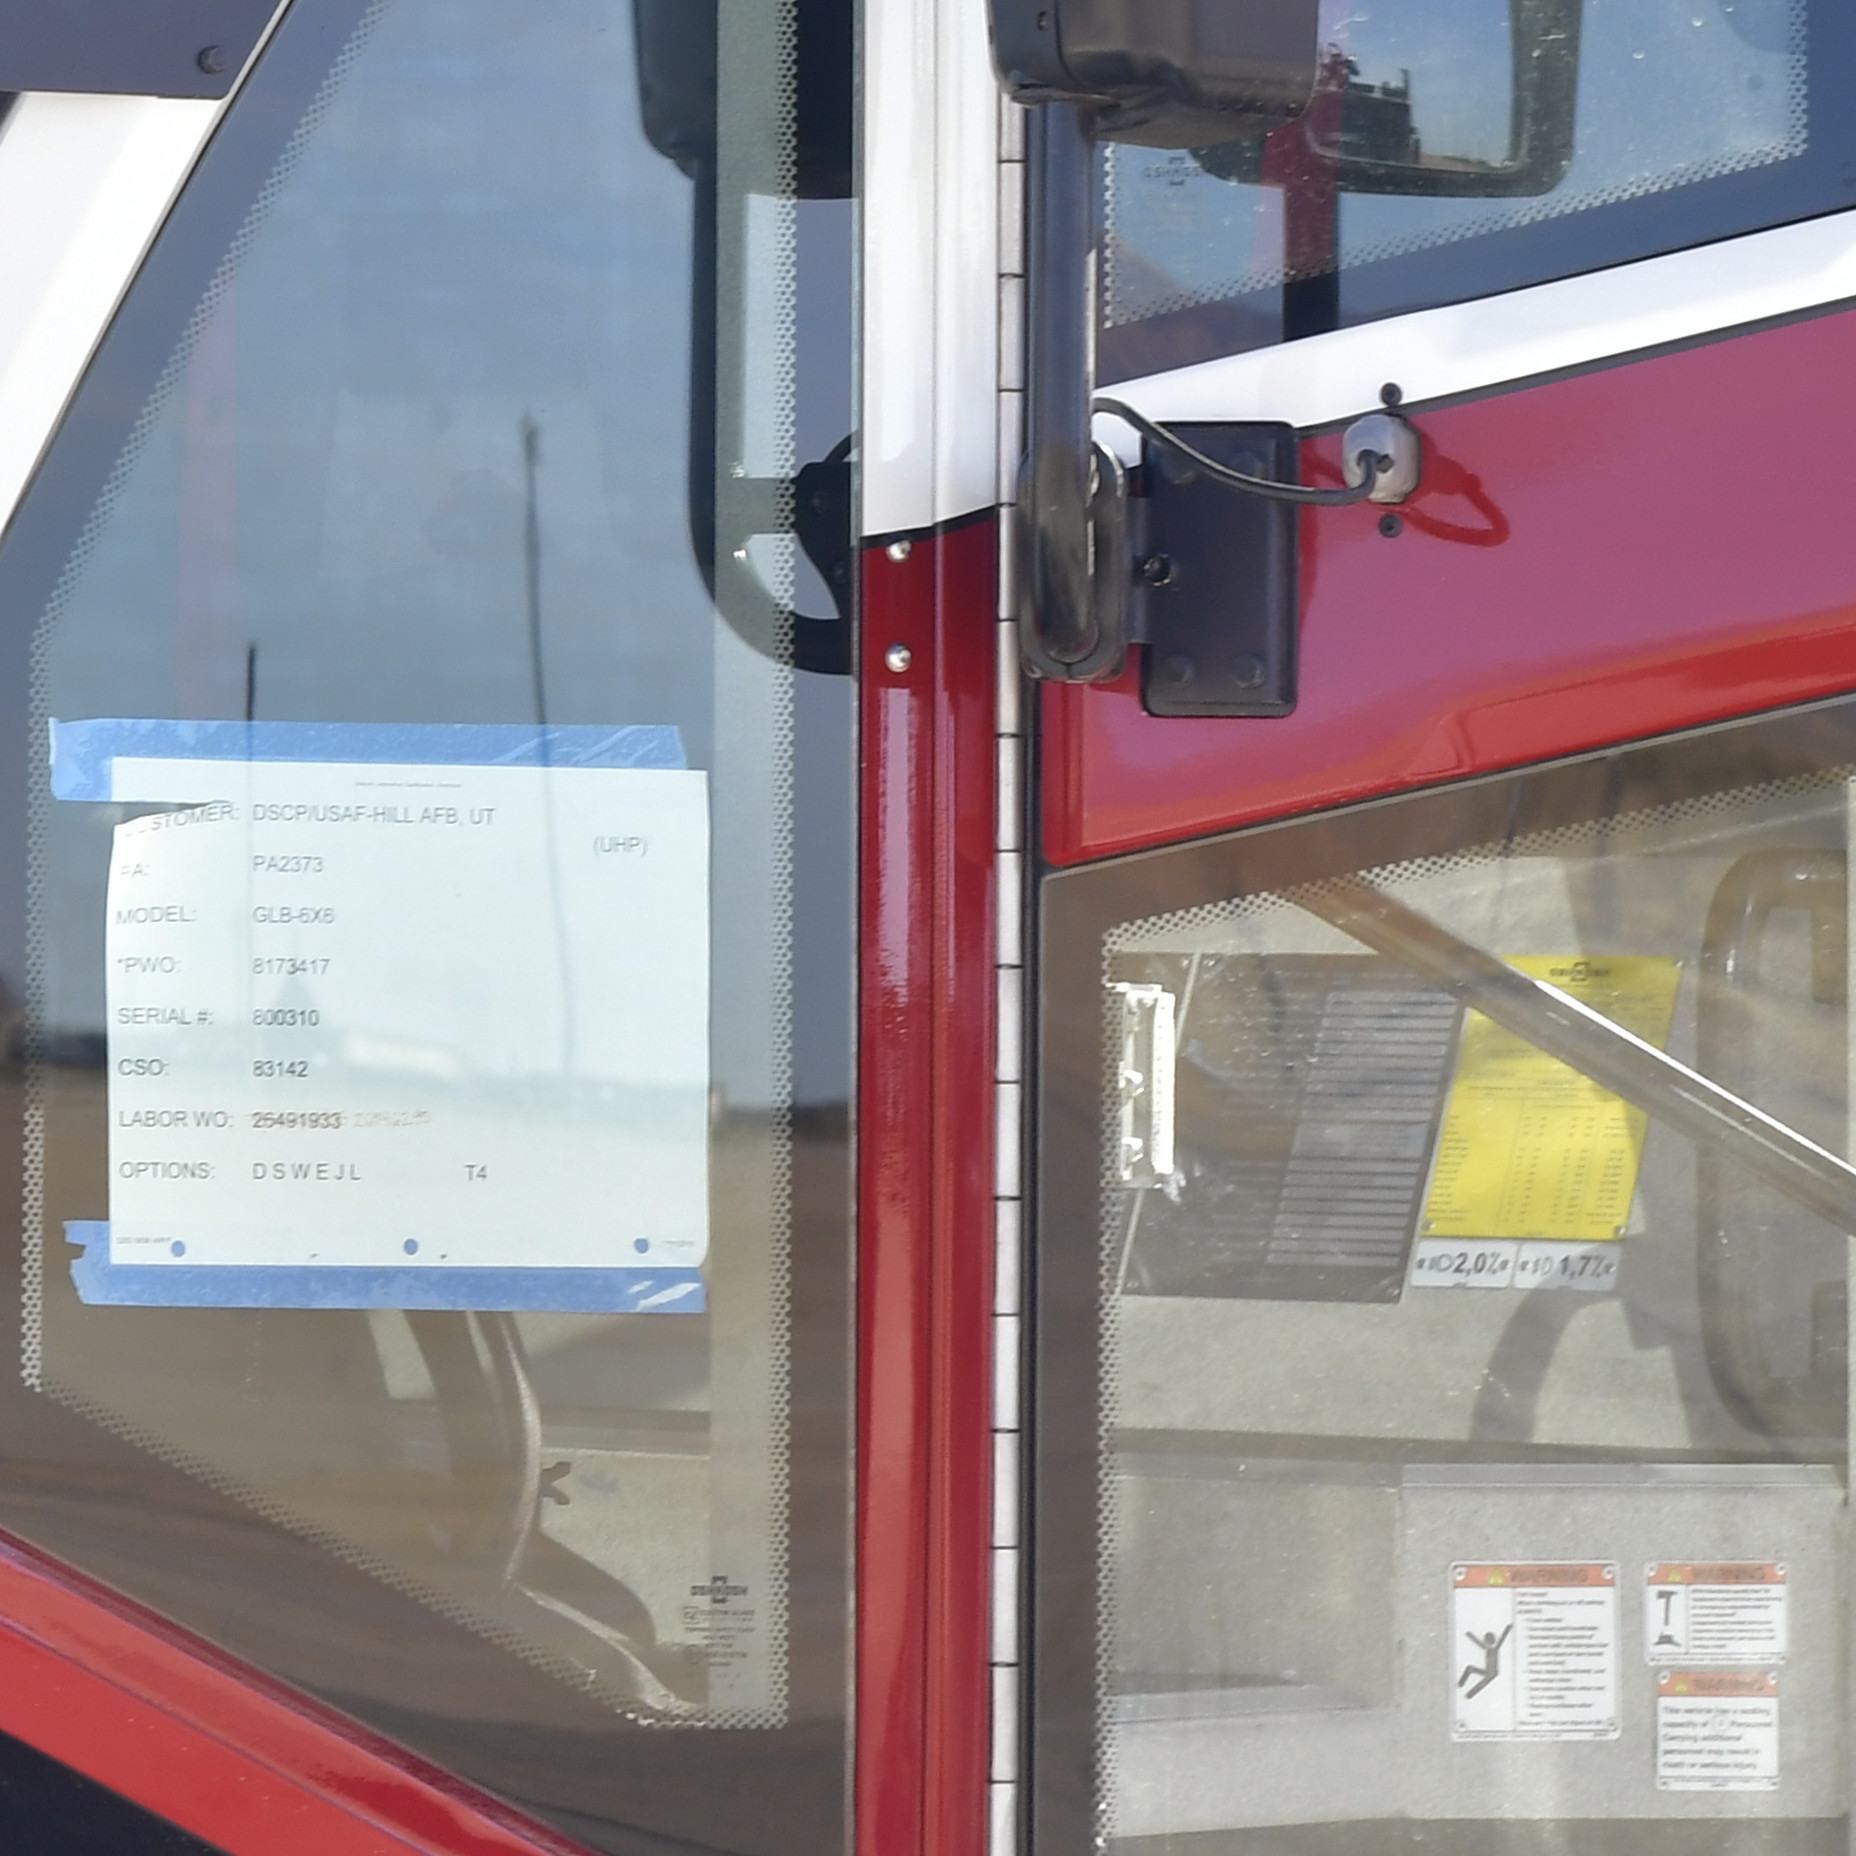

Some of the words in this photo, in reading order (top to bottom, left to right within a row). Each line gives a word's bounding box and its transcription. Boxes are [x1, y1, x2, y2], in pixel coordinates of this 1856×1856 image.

[251, 803, 414, 826] DSCP/USAF-HILL
[469, 808, 496, 826] UT
[592, 836, 649, 857] (UHP)
[251, 855, 325, 874] PA2373
[115, 904, 197, 926] MODEL:
[251, 956, 331, 976] 8173417
[117, 1007, 193, 1026] SERIAL
[117, 1058, 170, 1078] CSO:
[251, 1059, 309, 1079] 83142
[117, 1108, 189, 1129] LABOR
[192, 1109, 234, 1129] WO:
[117, 1160, 216, 1181] OPTIONS:
[464, 1164, 489, 1183] T4
